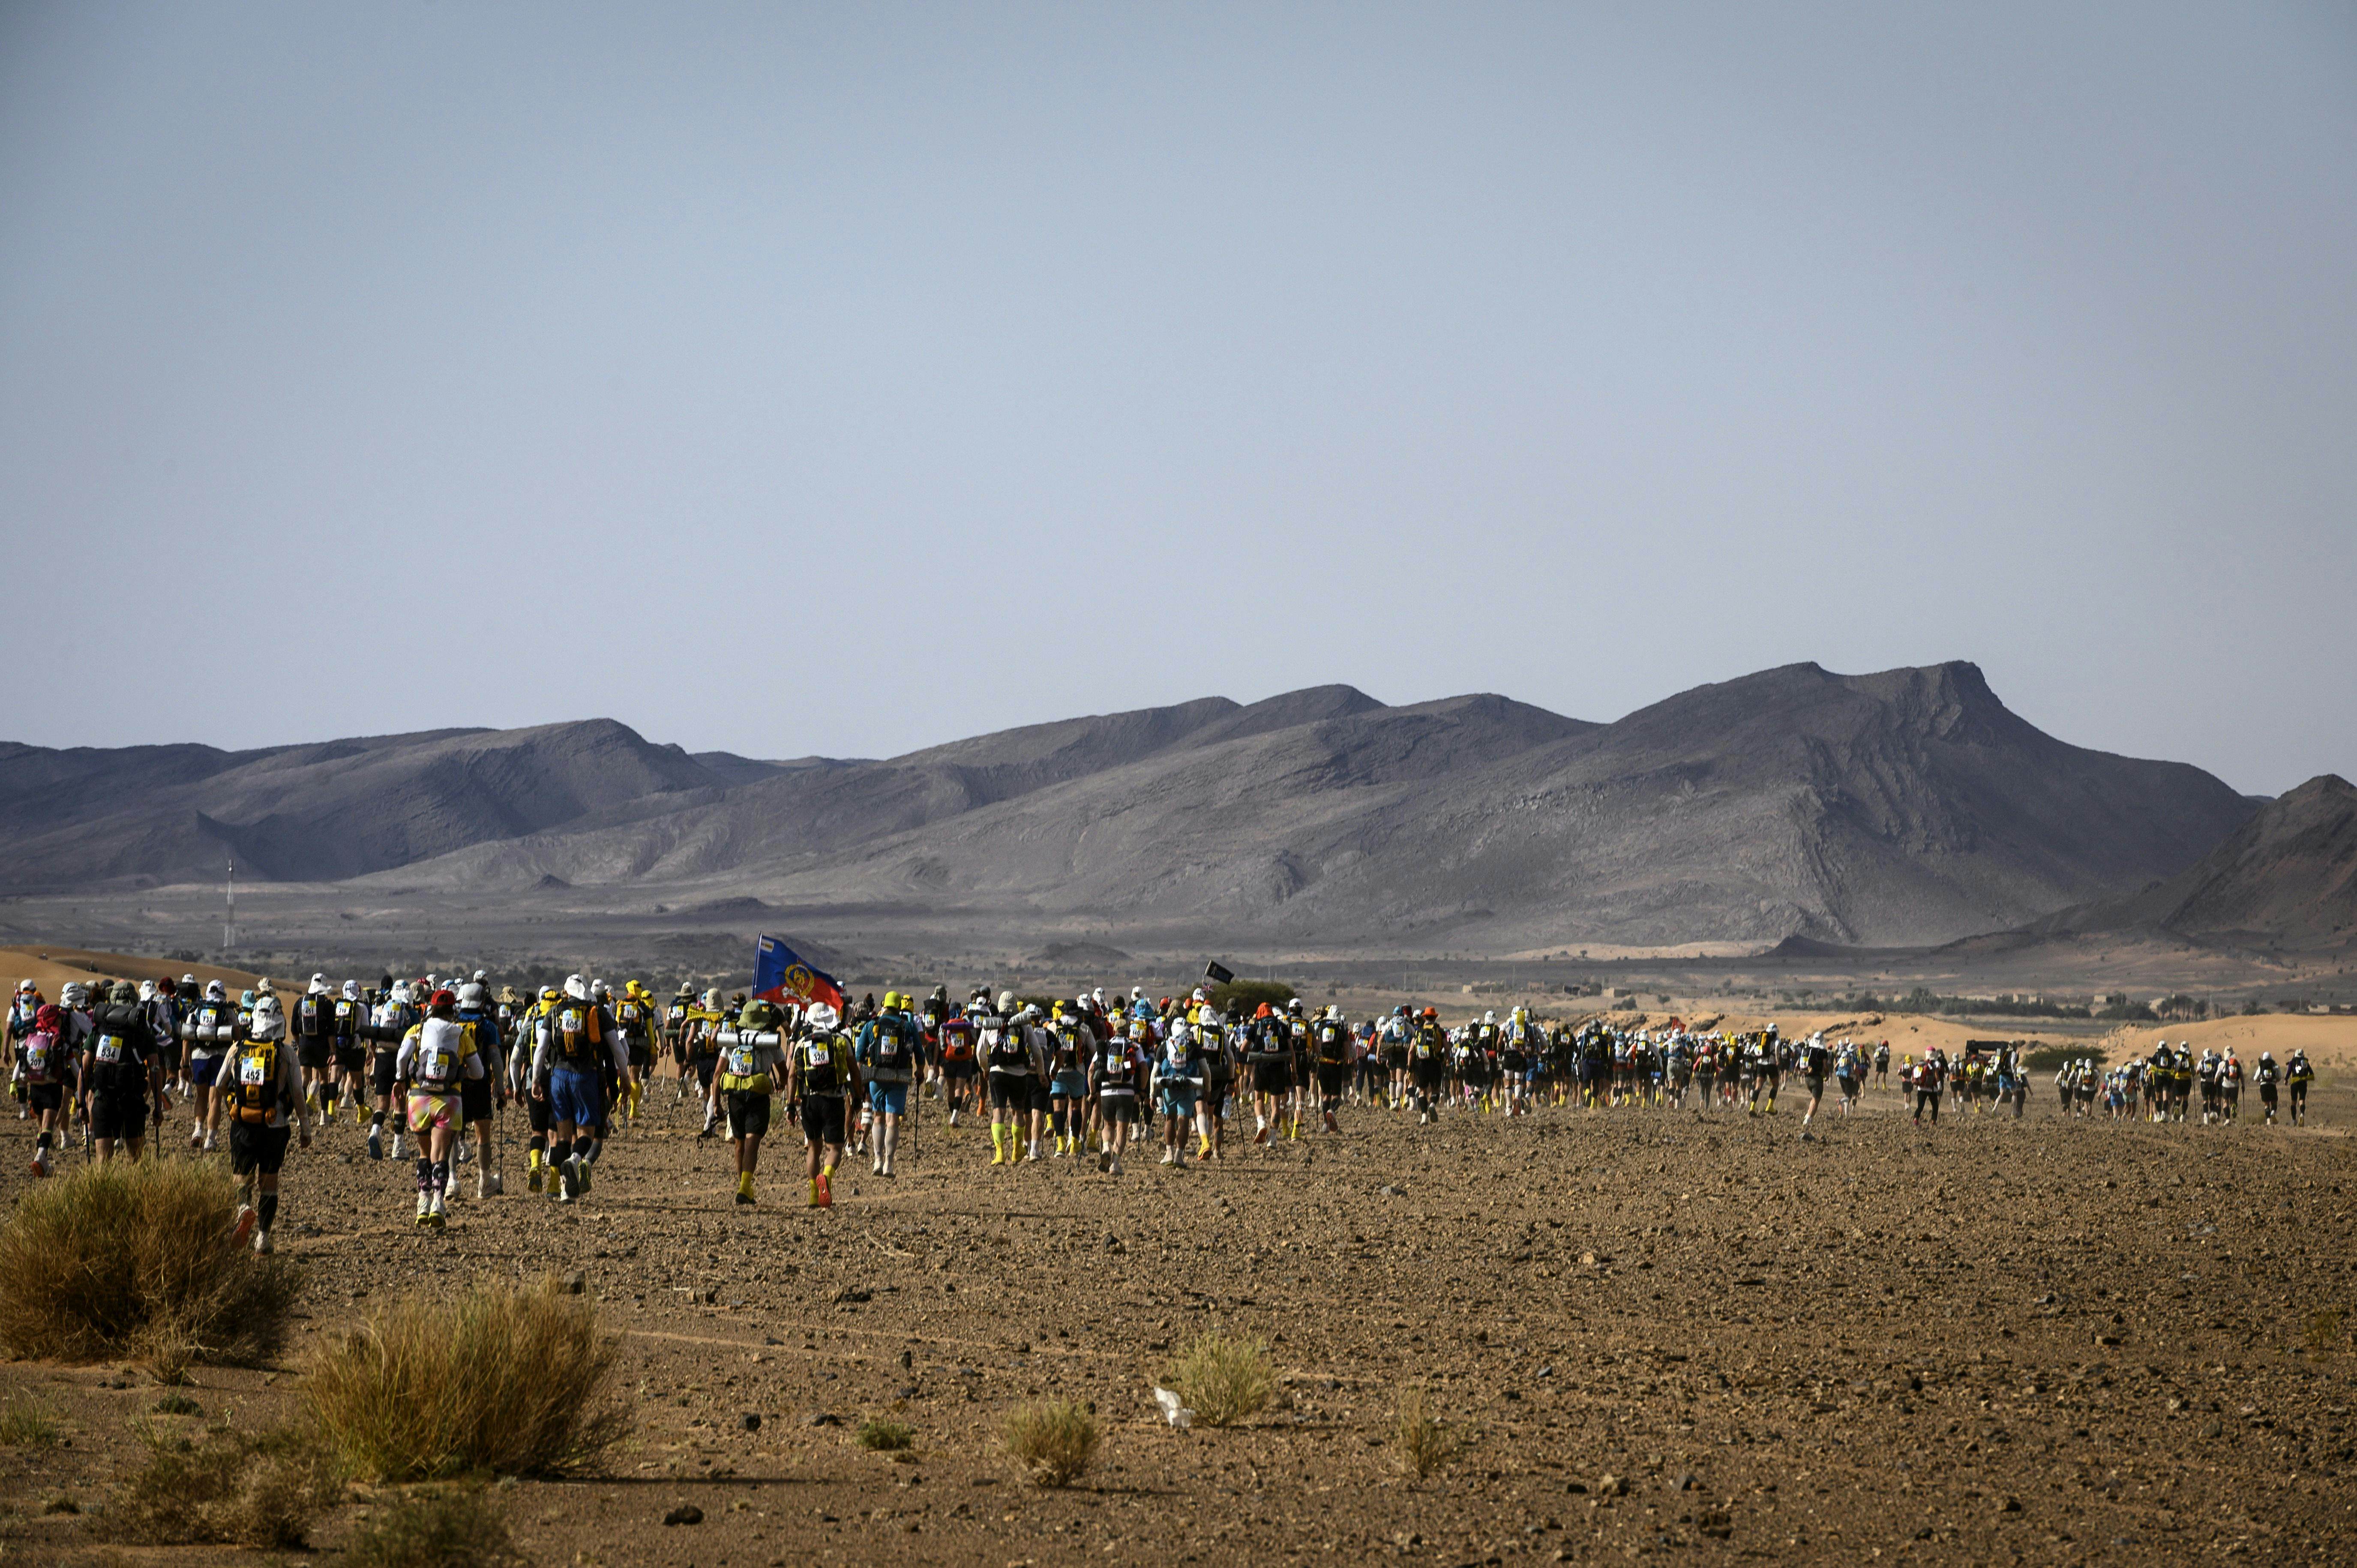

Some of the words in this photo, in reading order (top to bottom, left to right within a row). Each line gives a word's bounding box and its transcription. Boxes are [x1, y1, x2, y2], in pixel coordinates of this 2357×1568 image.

[566, 1019, 578, 1029] 605
[813, 1052, 825, 1061] 320
[30, 1058, 42, 1067] 207
[245, 1069, 260, 1080] 452
